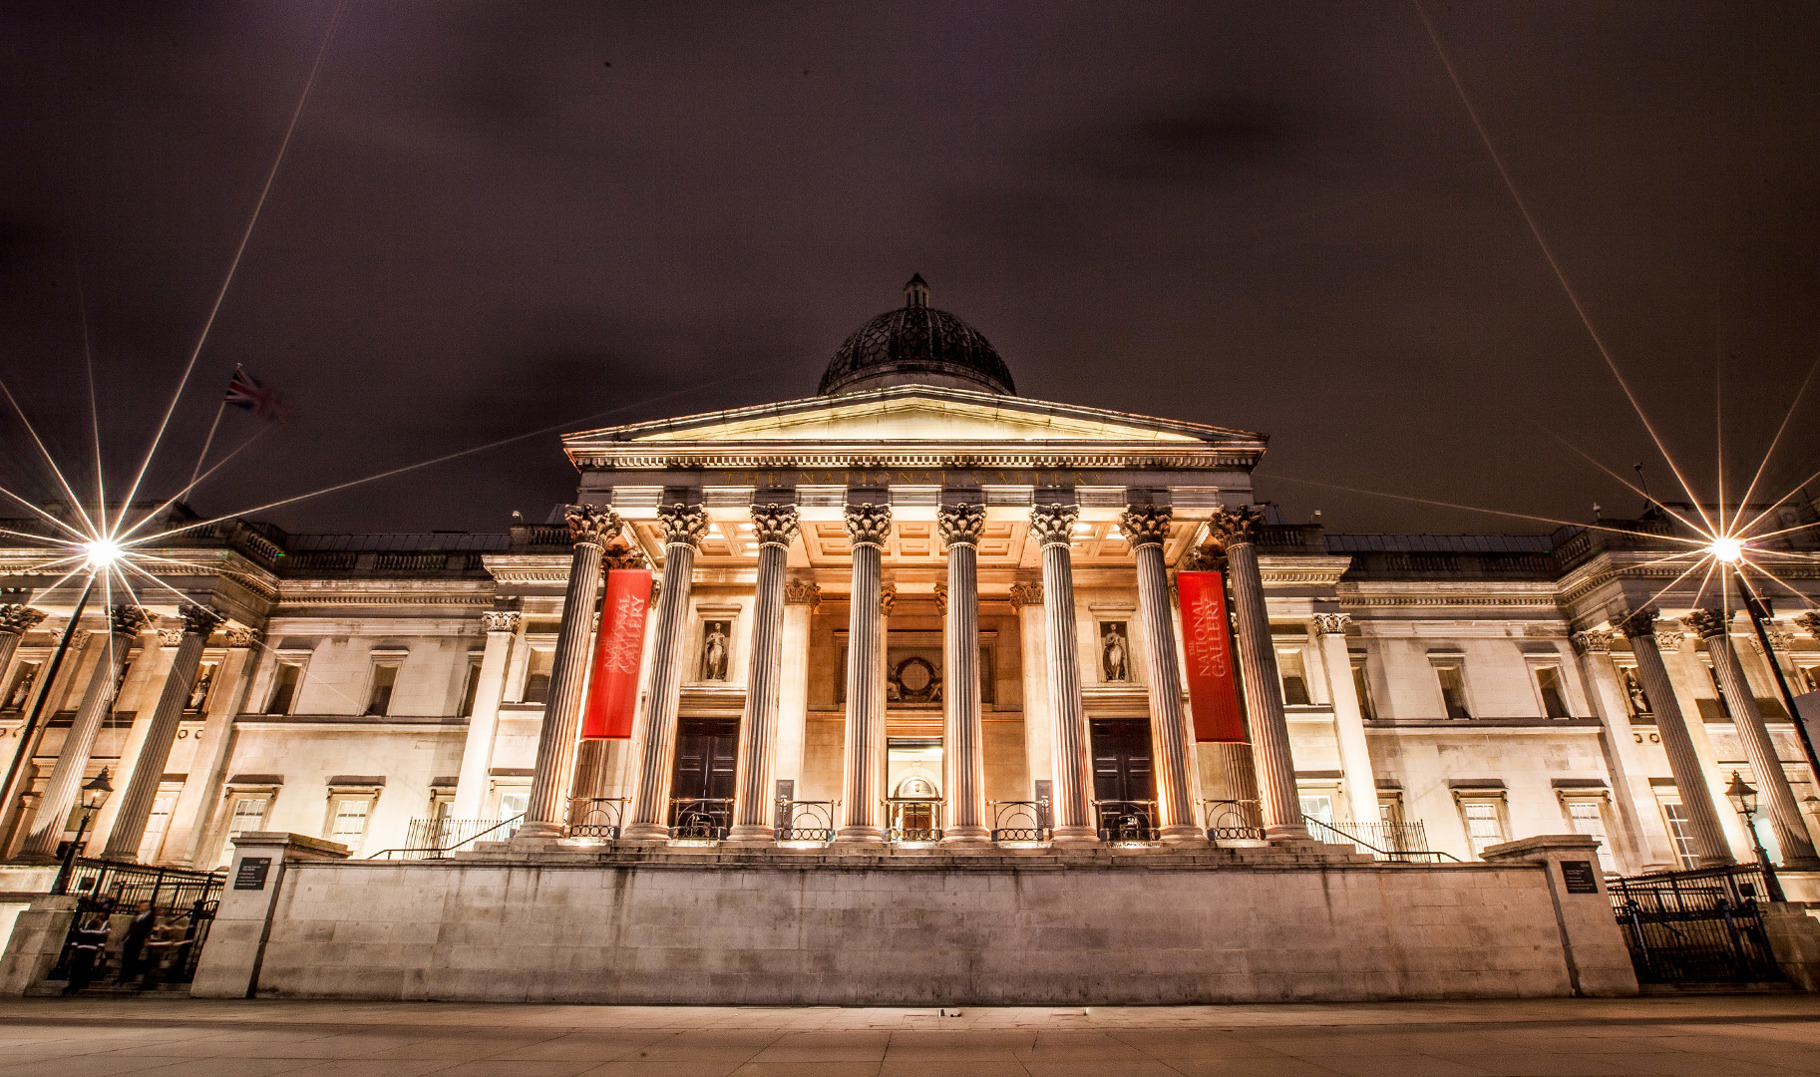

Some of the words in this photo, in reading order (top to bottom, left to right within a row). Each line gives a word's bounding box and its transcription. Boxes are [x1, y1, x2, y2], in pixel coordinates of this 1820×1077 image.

[723, 472, 777, 486] THE
[800, 471, 950, 486] NATIONAL
[972, 471, 1105, 486] GALLERY
[1191, 597, 1211, 677] NATIONAL
[1204, 597, 1226, 677] GALLERY
